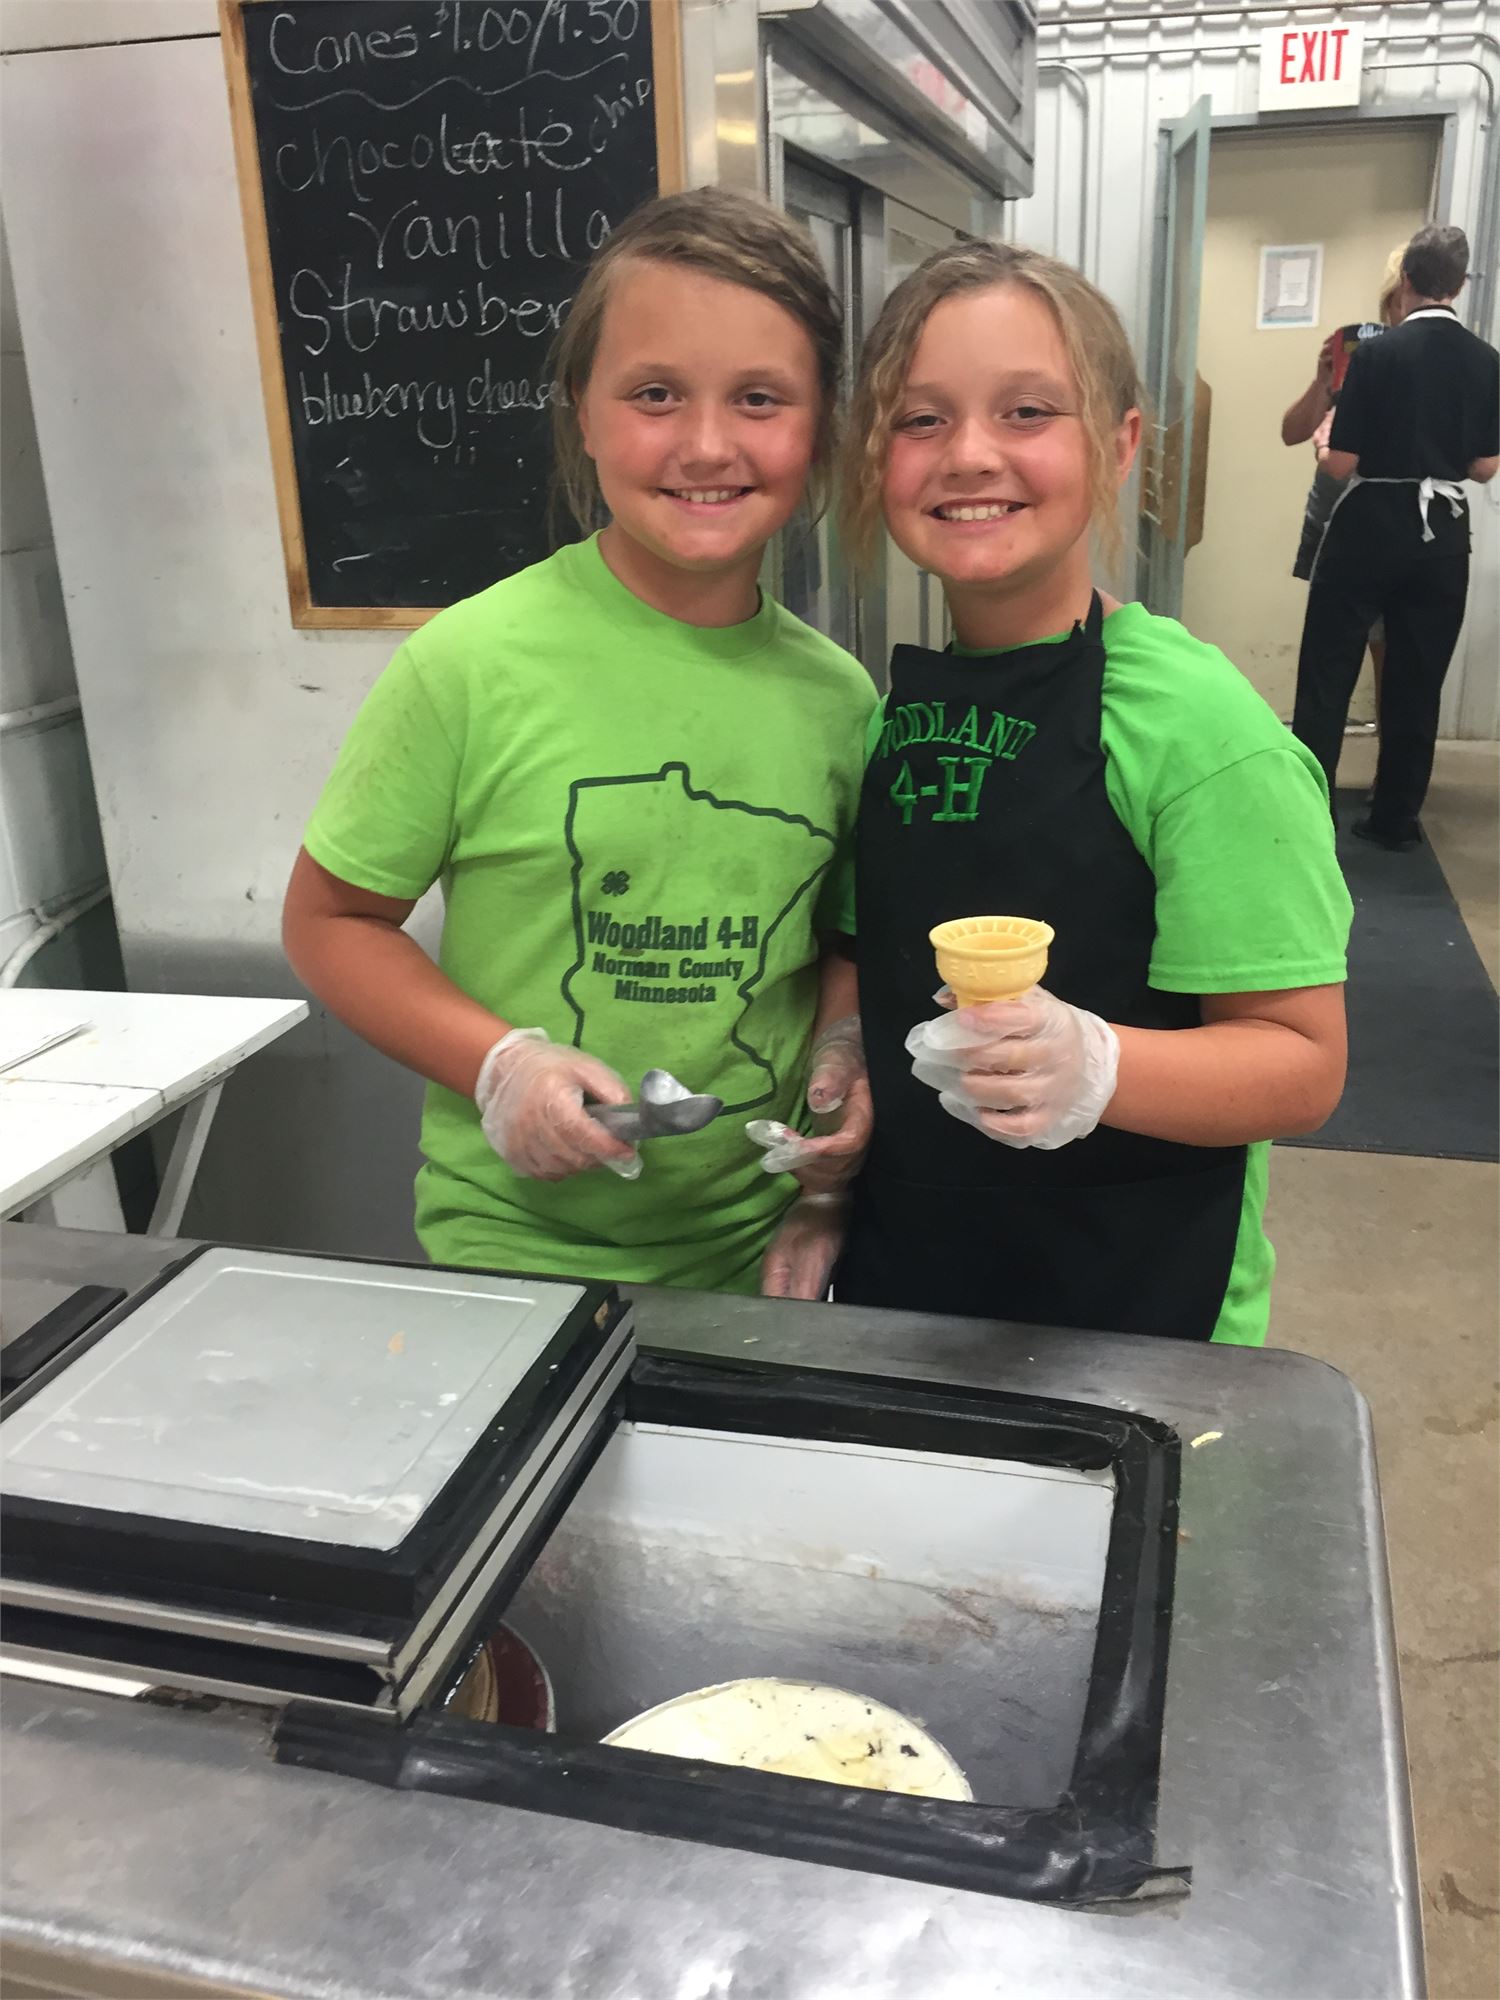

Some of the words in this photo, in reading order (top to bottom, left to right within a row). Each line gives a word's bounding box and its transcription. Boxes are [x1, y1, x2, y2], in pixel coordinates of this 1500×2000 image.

[1280, 29, 1350, 84] EXIT
[289, 262, 573, 356] Strawber
[889, 756, 993, 825] 4-H
[587, 911, 709, 951] Woodland
[716, 915, 759, 949] 4-H
[591, 951, 670, 979] Norman
[679, 957, 745, 981] County
[614, 979, 717, 1004] Minnesota
